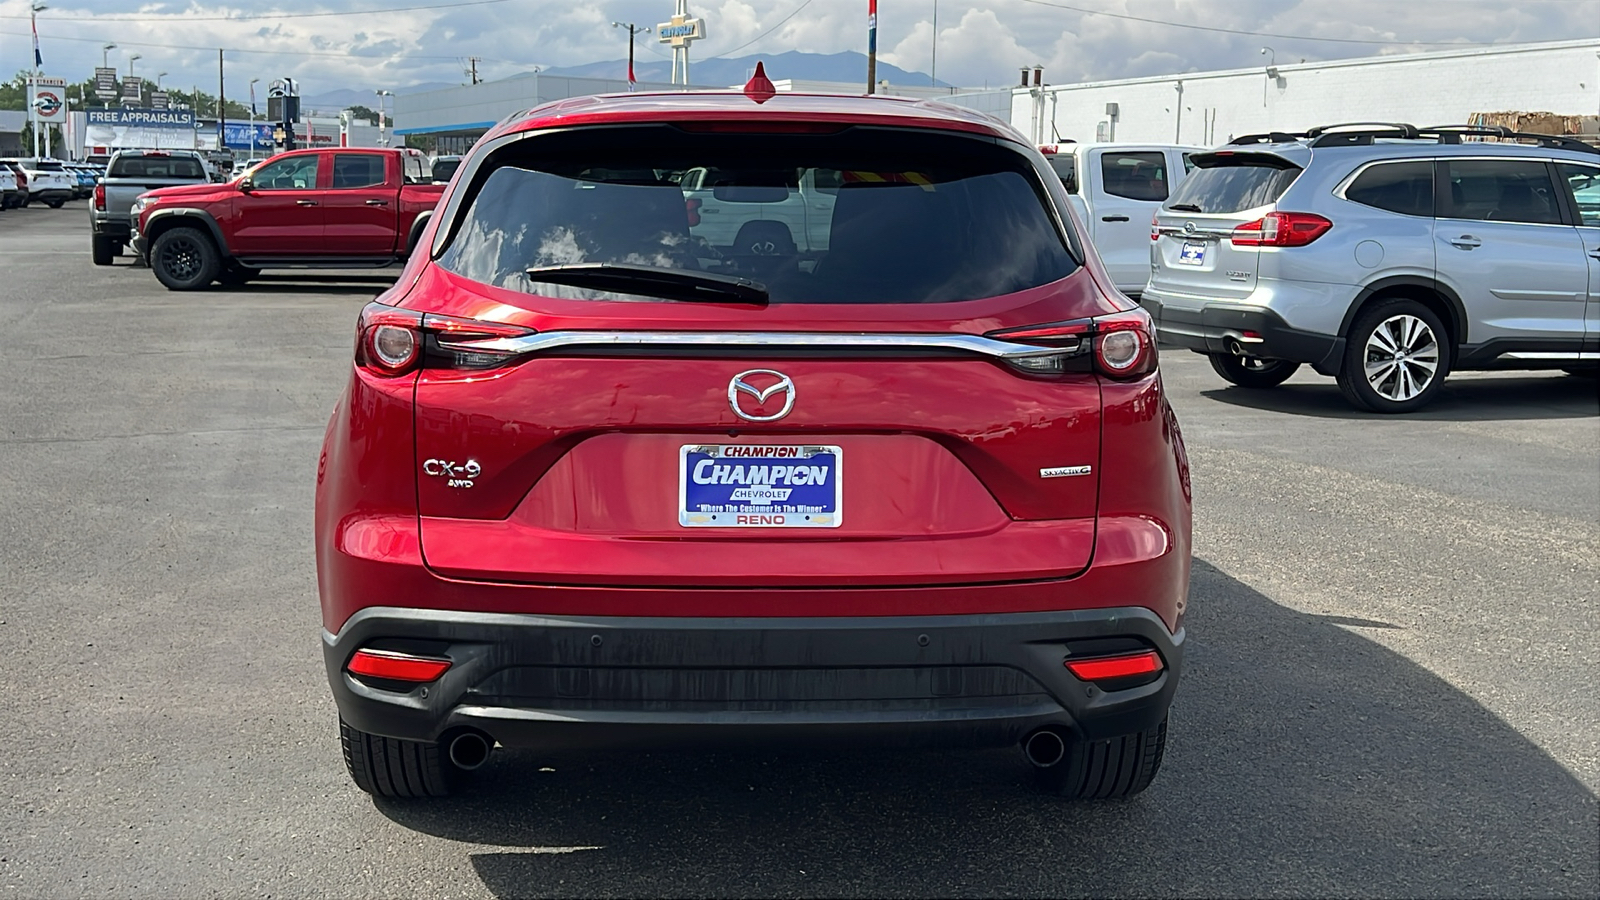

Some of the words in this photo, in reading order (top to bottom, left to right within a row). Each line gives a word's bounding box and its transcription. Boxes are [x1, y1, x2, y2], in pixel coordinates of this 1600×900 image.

[661, 25, 694, 38] CHEVROLET
[90, 112, 118, 122] FREE
[121, 112, 191, 124] APPRAISALS!
[724, 446, 798, 457] CHAMPION
[423, 459, 481, 478] CX-9
[693, 459, 828, 485] CHAMPION
[448, 479, 473, 488] AWD
[734, 490, 787, 498] CHEVROLET
[725, 504, 738, 513] The
[740, 504, 773, 513] Customer
[774, 504, 782, 513] Is
[783, 504, 796, 513] The
[737, 515, 785, 525] RENO
